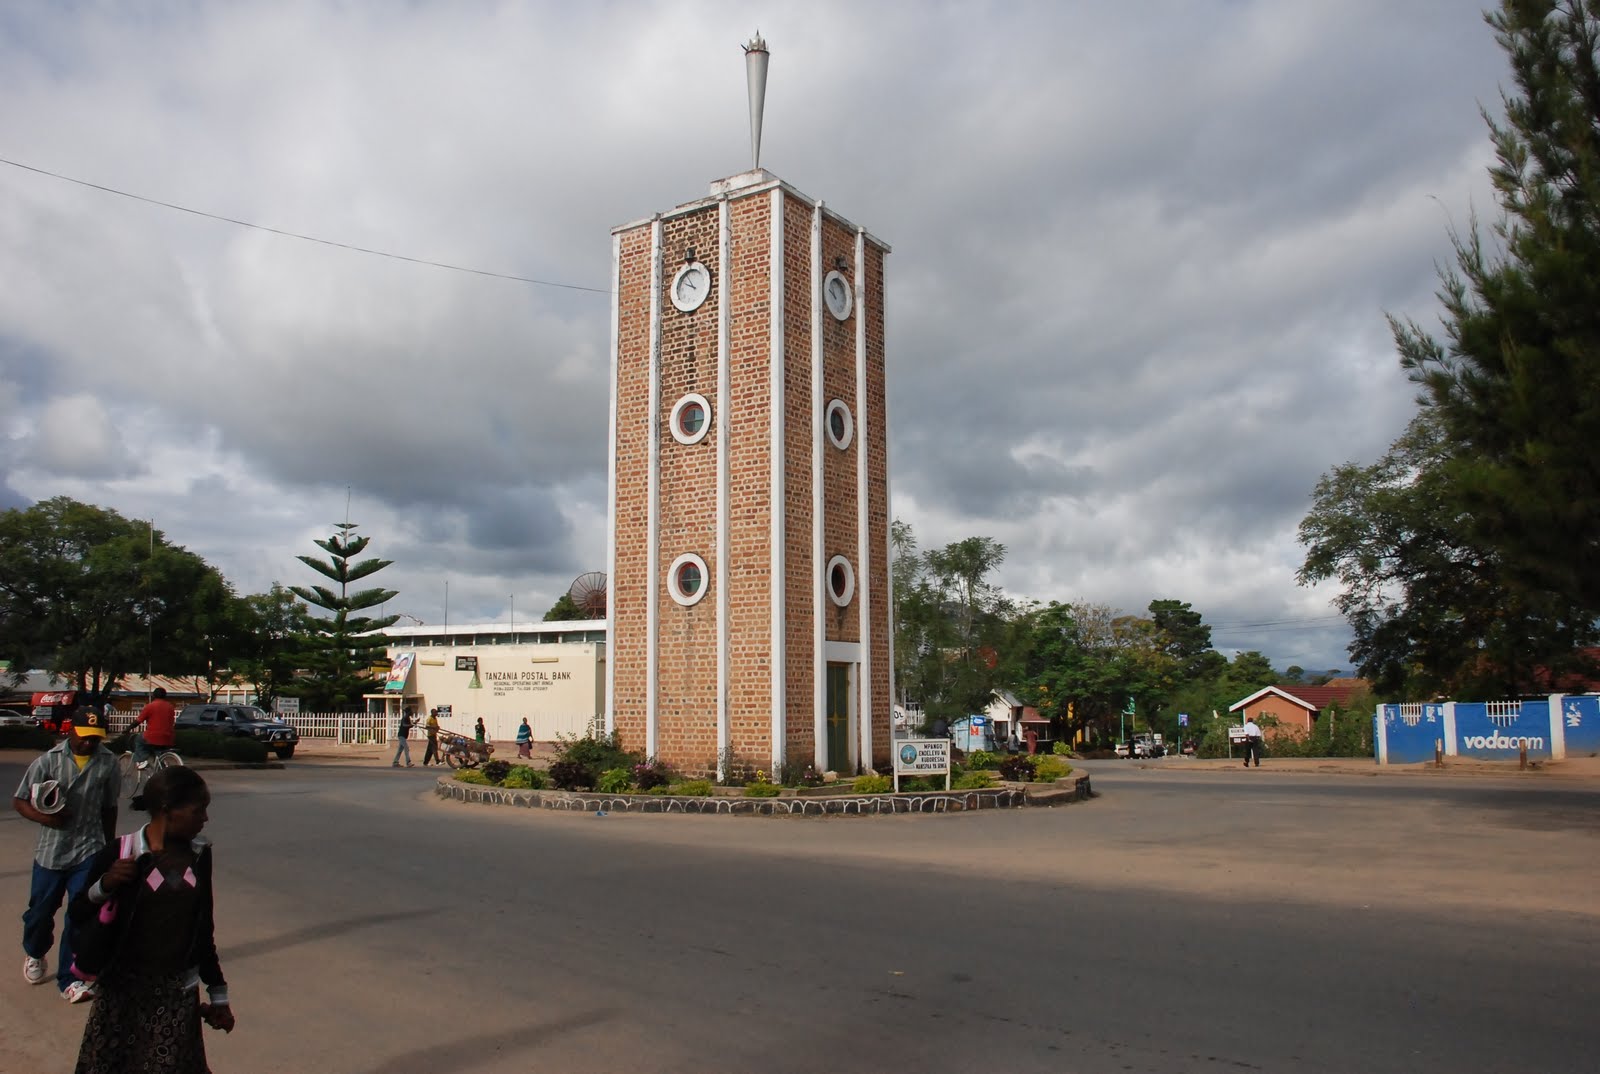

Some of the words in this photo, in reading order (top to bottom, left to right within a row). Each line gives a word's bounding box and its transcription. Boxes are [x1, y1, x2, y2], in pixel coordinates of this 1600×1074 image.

[485, 672, 518, 680] TANZANIA
[521, 672, 548, 680] POSTAL
[552, 672, 571, 680] BANK
[1463, 729, 1543, 750] vodacom
